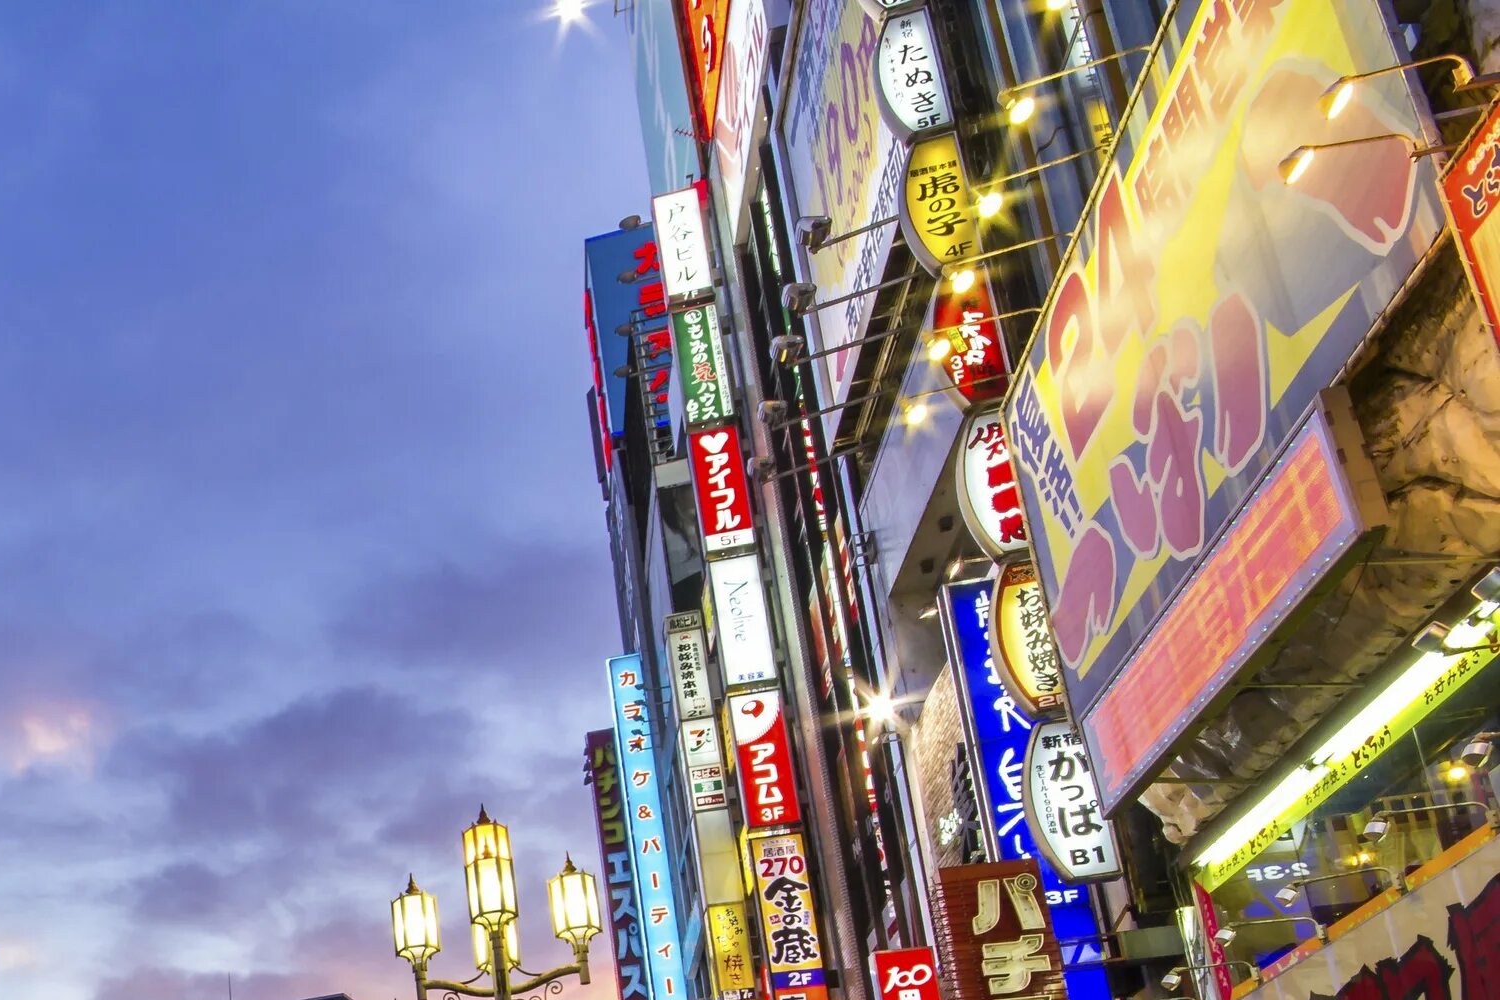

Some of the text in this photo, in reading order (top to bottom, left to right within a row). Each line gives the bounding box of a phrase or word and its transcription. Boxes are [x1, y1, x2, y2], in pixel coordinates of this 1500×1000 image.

[899, 43, 937, 112] たぬき
[916, 113, 942, 129] 5F
[916, 173, 968, 237] 虎の子
[668, 201, 698, 283] 戸谷ビル
[944, 240, 973, 258] 4F
[687, 321, 720, 421] もみの気ハウス
[949, 355, 965, 385] 3F
[686, 399, 699, 422] 6F
[704, 453, 741, 532] アイフル
[719, 534, 742, 546] 5F
[1015, 586, 1061, 692] お好み焼き
[1423, 648, 1482, 706] お好み焼き
[593, 741, 626, 846] パチンコ
[749, 742, 783, 803] アコム
[761, 805, 785, 822] 3F
[1048, 750, 1104, 840] かっぱ
[759, 857, 804, 878] 270
[762, 845, 796, 857] 居酒屋
[1069, 846, 1106, 866] B1
[1045, 889, 1079, 905] 3F
[606, 853, 648, 1000] エスパス
[765, 875, 819, 965] 金の蔵
[741, 989, 754, 1000] 7F
[787, 972, 812, 986] 2F
